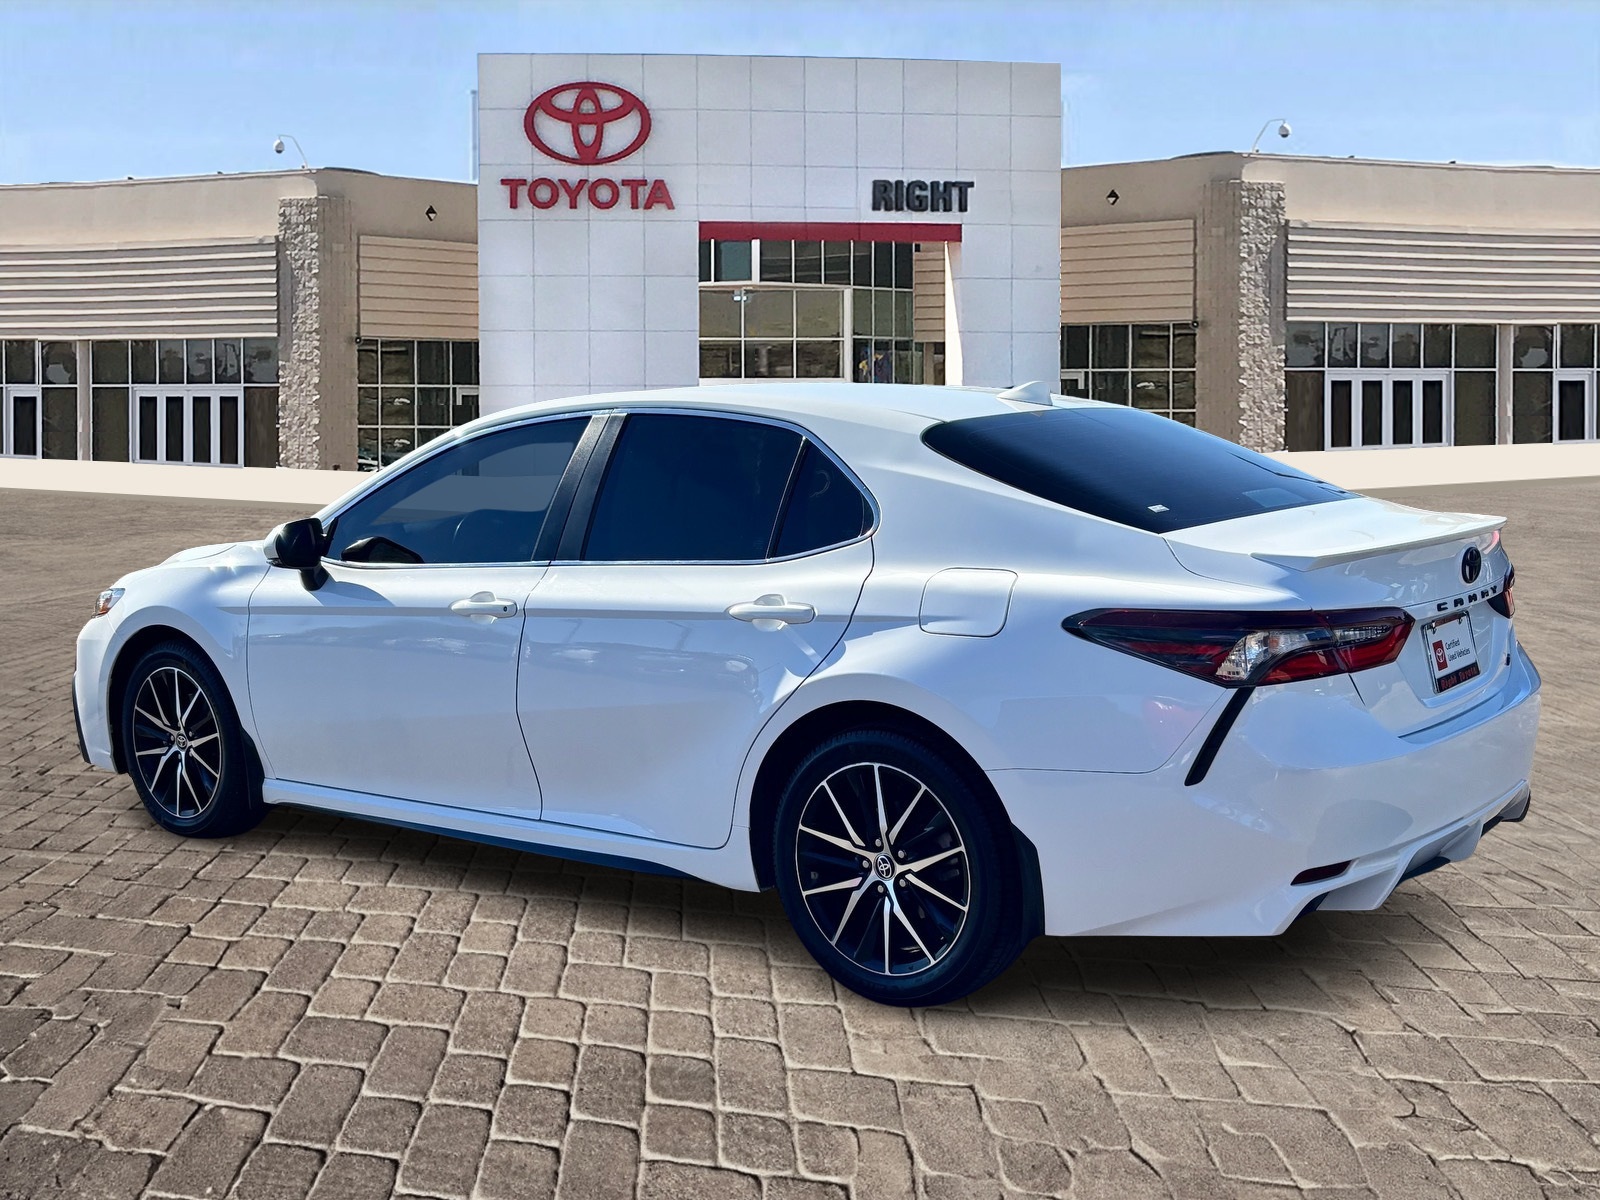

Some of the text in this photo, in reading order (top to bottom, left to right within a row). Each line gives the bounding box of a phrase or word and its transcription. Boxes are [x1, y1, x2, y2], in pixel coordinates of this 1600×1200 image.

[500, 178, 675, 210] TOYOTA
[872, 179, 975, 213] RIGHT
[1437, 585, 1497, 612] CAMRY
[1445, 638, 1460, 650] Certified
[1456, 648, 1471, 658] Vehicles
